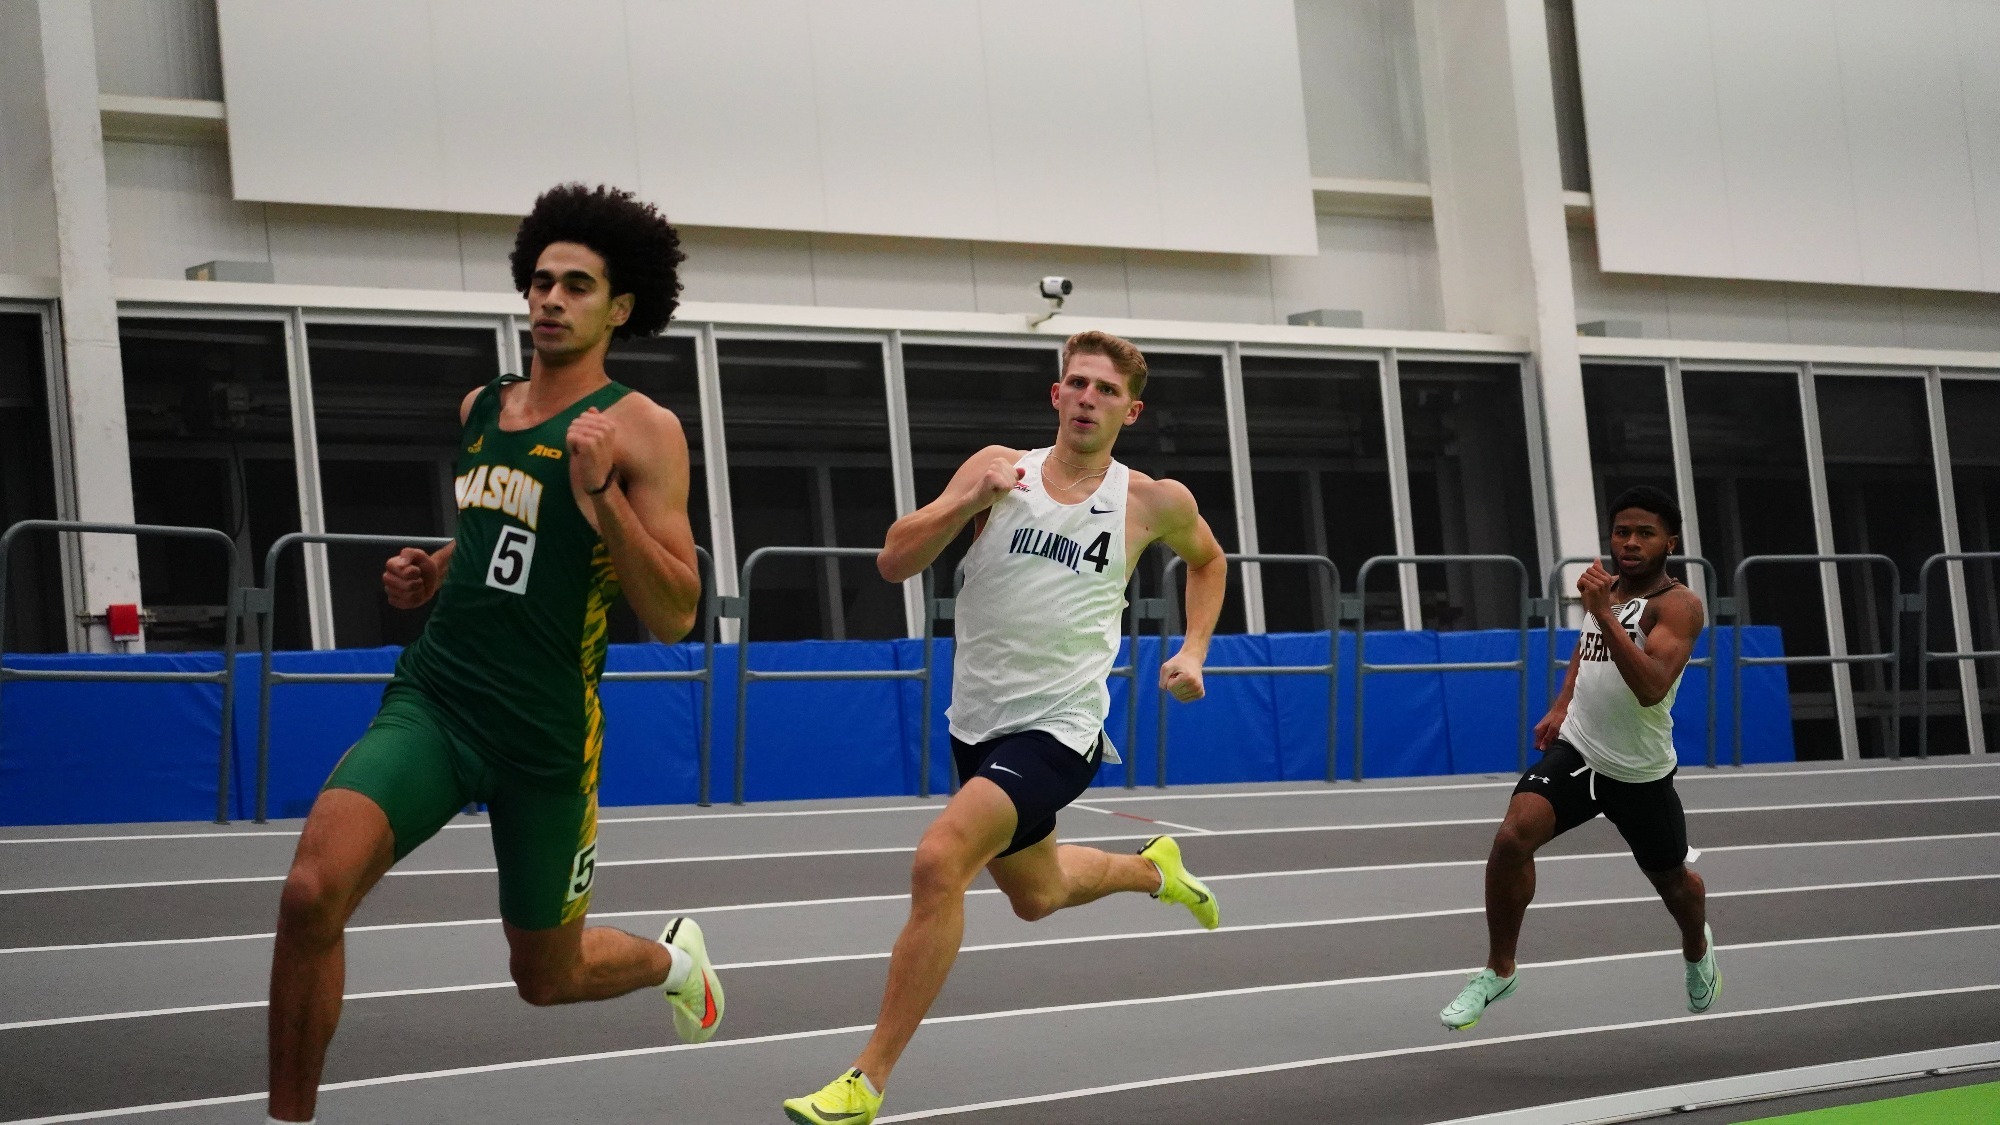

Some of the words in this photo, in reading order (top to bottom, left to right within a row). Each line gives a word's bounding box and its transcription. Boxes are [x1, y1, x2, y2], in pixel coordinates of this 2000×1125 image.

[493, 531, 528, 586] 5
[1083, 531, 1111, 573] 4
[1621, 600, 1641, 630] 2
[574, 843, 596, 894] 5
